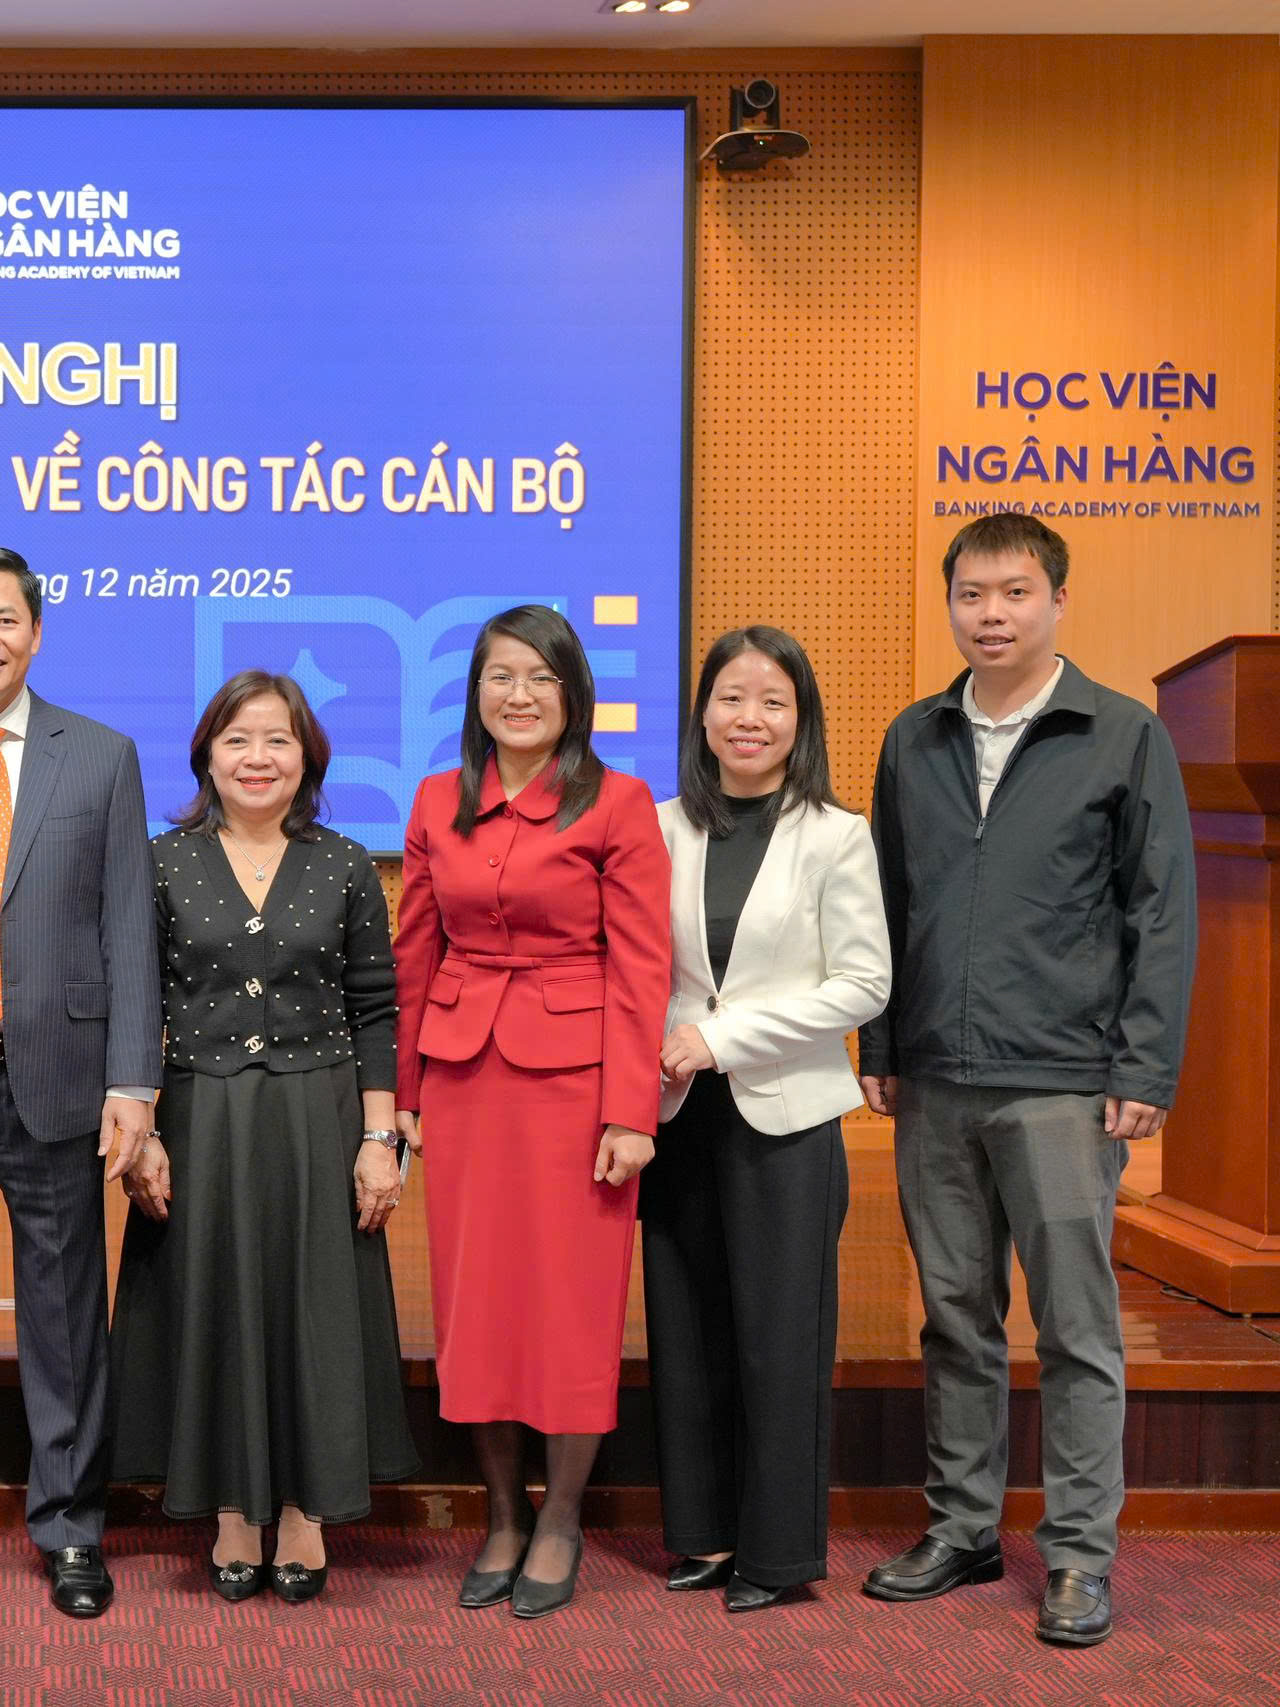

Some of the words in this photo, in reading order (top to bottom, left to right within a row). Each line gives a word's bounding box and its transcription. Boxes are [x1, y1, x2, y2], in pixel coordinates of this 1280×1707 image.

[36, 183, 128, 226] VIỆN
[68, 223, 181, 258] HÀNG
[18, 266, 90, 279] ACADEMY
[92, 266, 112, 279] OF
[114, 266, 179, 279] VIETNAM
[976, 371, 1090, 422] HỌC
[1099, 361, 1217, 422] VIỆN
[937, 435, 1088, 483] NGÂN
[1104, 432, 1256, 483] HÀNG
[12, 430, 81, 511] VỀ
[98, 441, 247, 512] CÔNG
[260, 441, 365, 512] TÁC
[382, 442, 493, 512] CÁN
[512, 442, 584, 529] BỘ
[934, 501, 1025, 517] BANKING
[1031, 502, 1130, 517] ACADEMY
[1134, 502, 1161, 517] OF
[1167, 502, 1260, 517] VIETNAM
[82, 568, 118, 596] 12
[128, 569, 199, 597] năm
[210, 569, 292, 596] 2025
